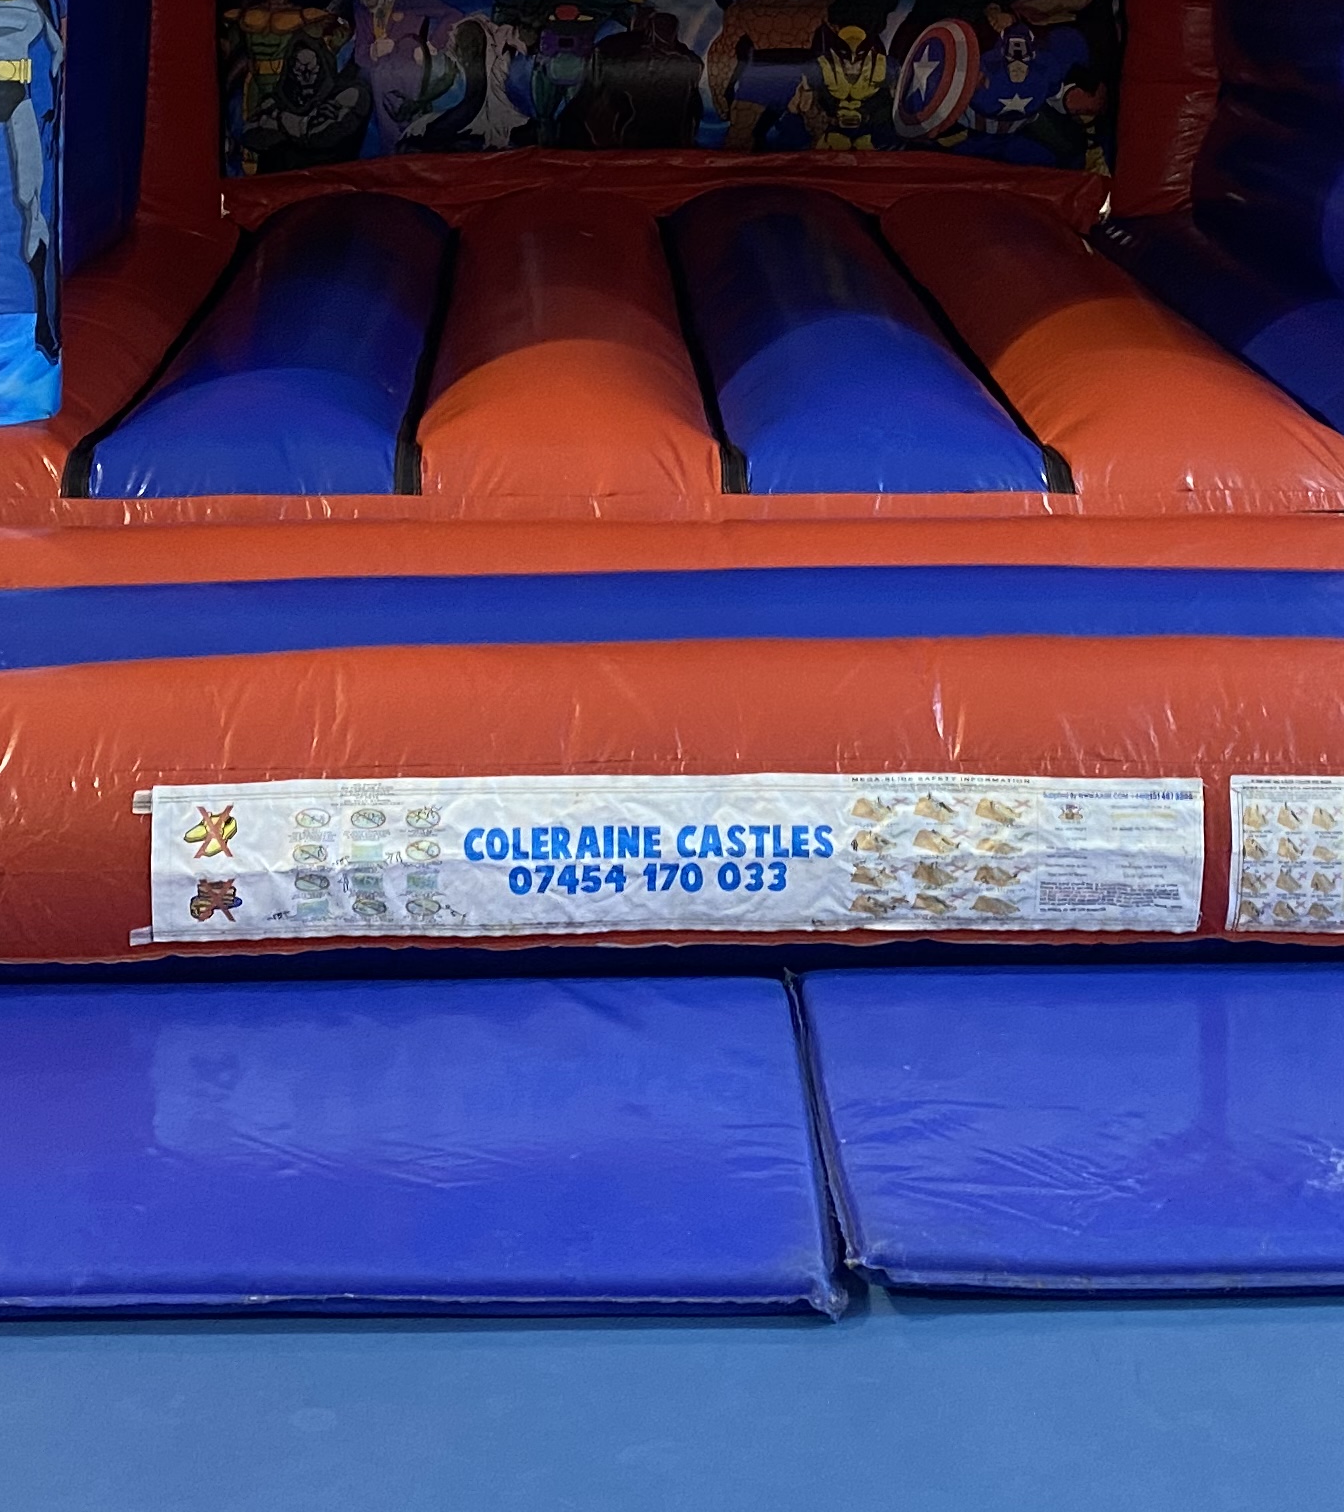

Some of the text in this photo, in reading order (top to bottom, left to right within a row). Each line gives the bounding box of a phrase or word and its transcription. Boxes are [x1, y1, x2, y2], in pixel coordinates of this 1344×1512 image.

[463, 825, 662, 861] COLERAINE
[676, 823, 834, 859] CASTLES
[508, 861, 787, 895] 07454 170 033
